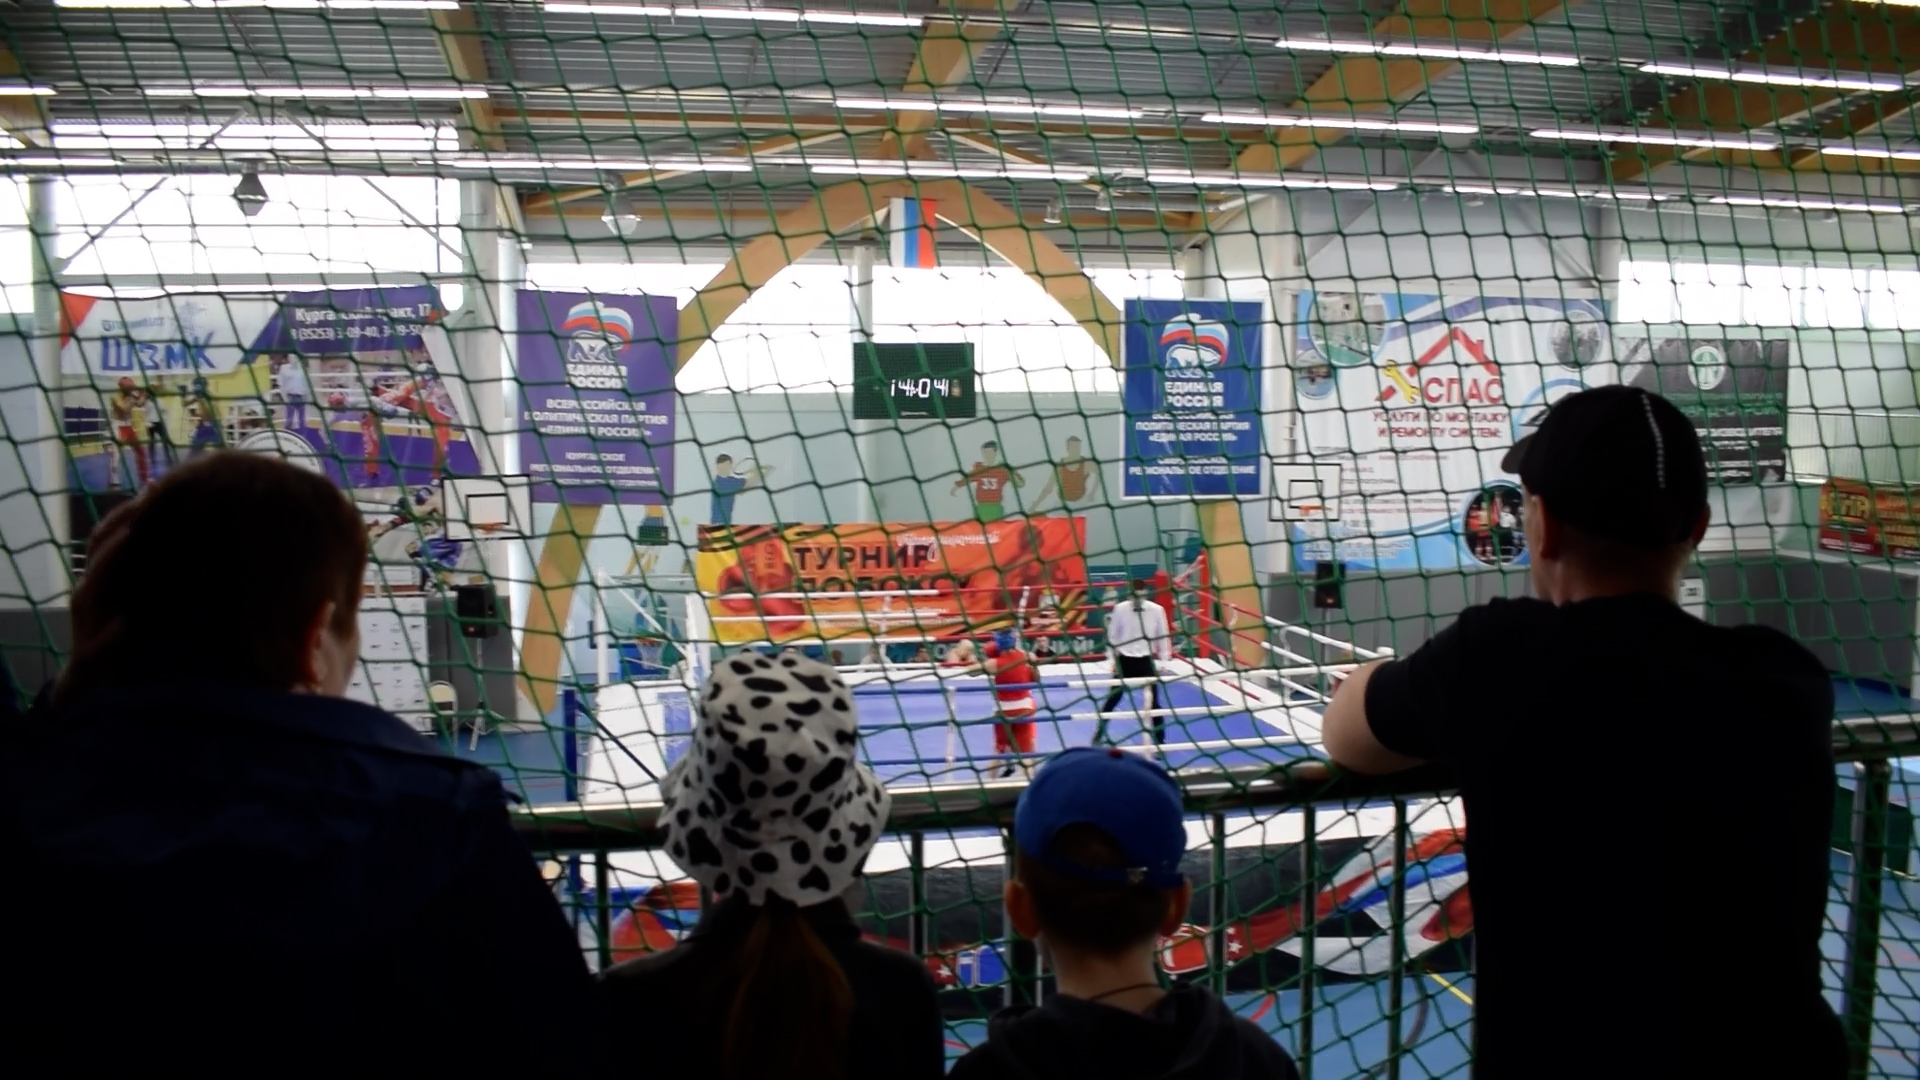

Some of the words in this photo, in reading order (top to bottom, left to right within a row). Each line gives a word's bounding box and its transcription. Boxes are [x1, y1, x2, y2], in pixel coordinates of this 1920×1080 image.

[295, 306, 376, 324] Кургаский
[101, 331, 216, 372] ШЗМК
[565, 363, 628, 377] ЕДИНАЯ
[564, 376, 628, 389] РОССИ
[1164, 381, 1224, 395] ЕДИНАЯ
[1423, 376, 1502, 404] СПАС
[1373, 411, 1420, 423] УСЛУГИ
[1423, 411, 1443, 422] ПО
[597, 427, 652, 437] РОССИ»
[1135, 422, 1211, 431] ПОЛИТИЕСКАЯ
[1391, 427, 1446, 438] РЕМОНТУ
[1193, 432, 1238, 442] РОССЯ»
[1128, 465, 1201, 475] РЕИОНАЛЬОЕ
[1202, 465, 1257, 475] ОТДЕЕНИЕ
[793, 544, 932, 571] ТУРНИР
